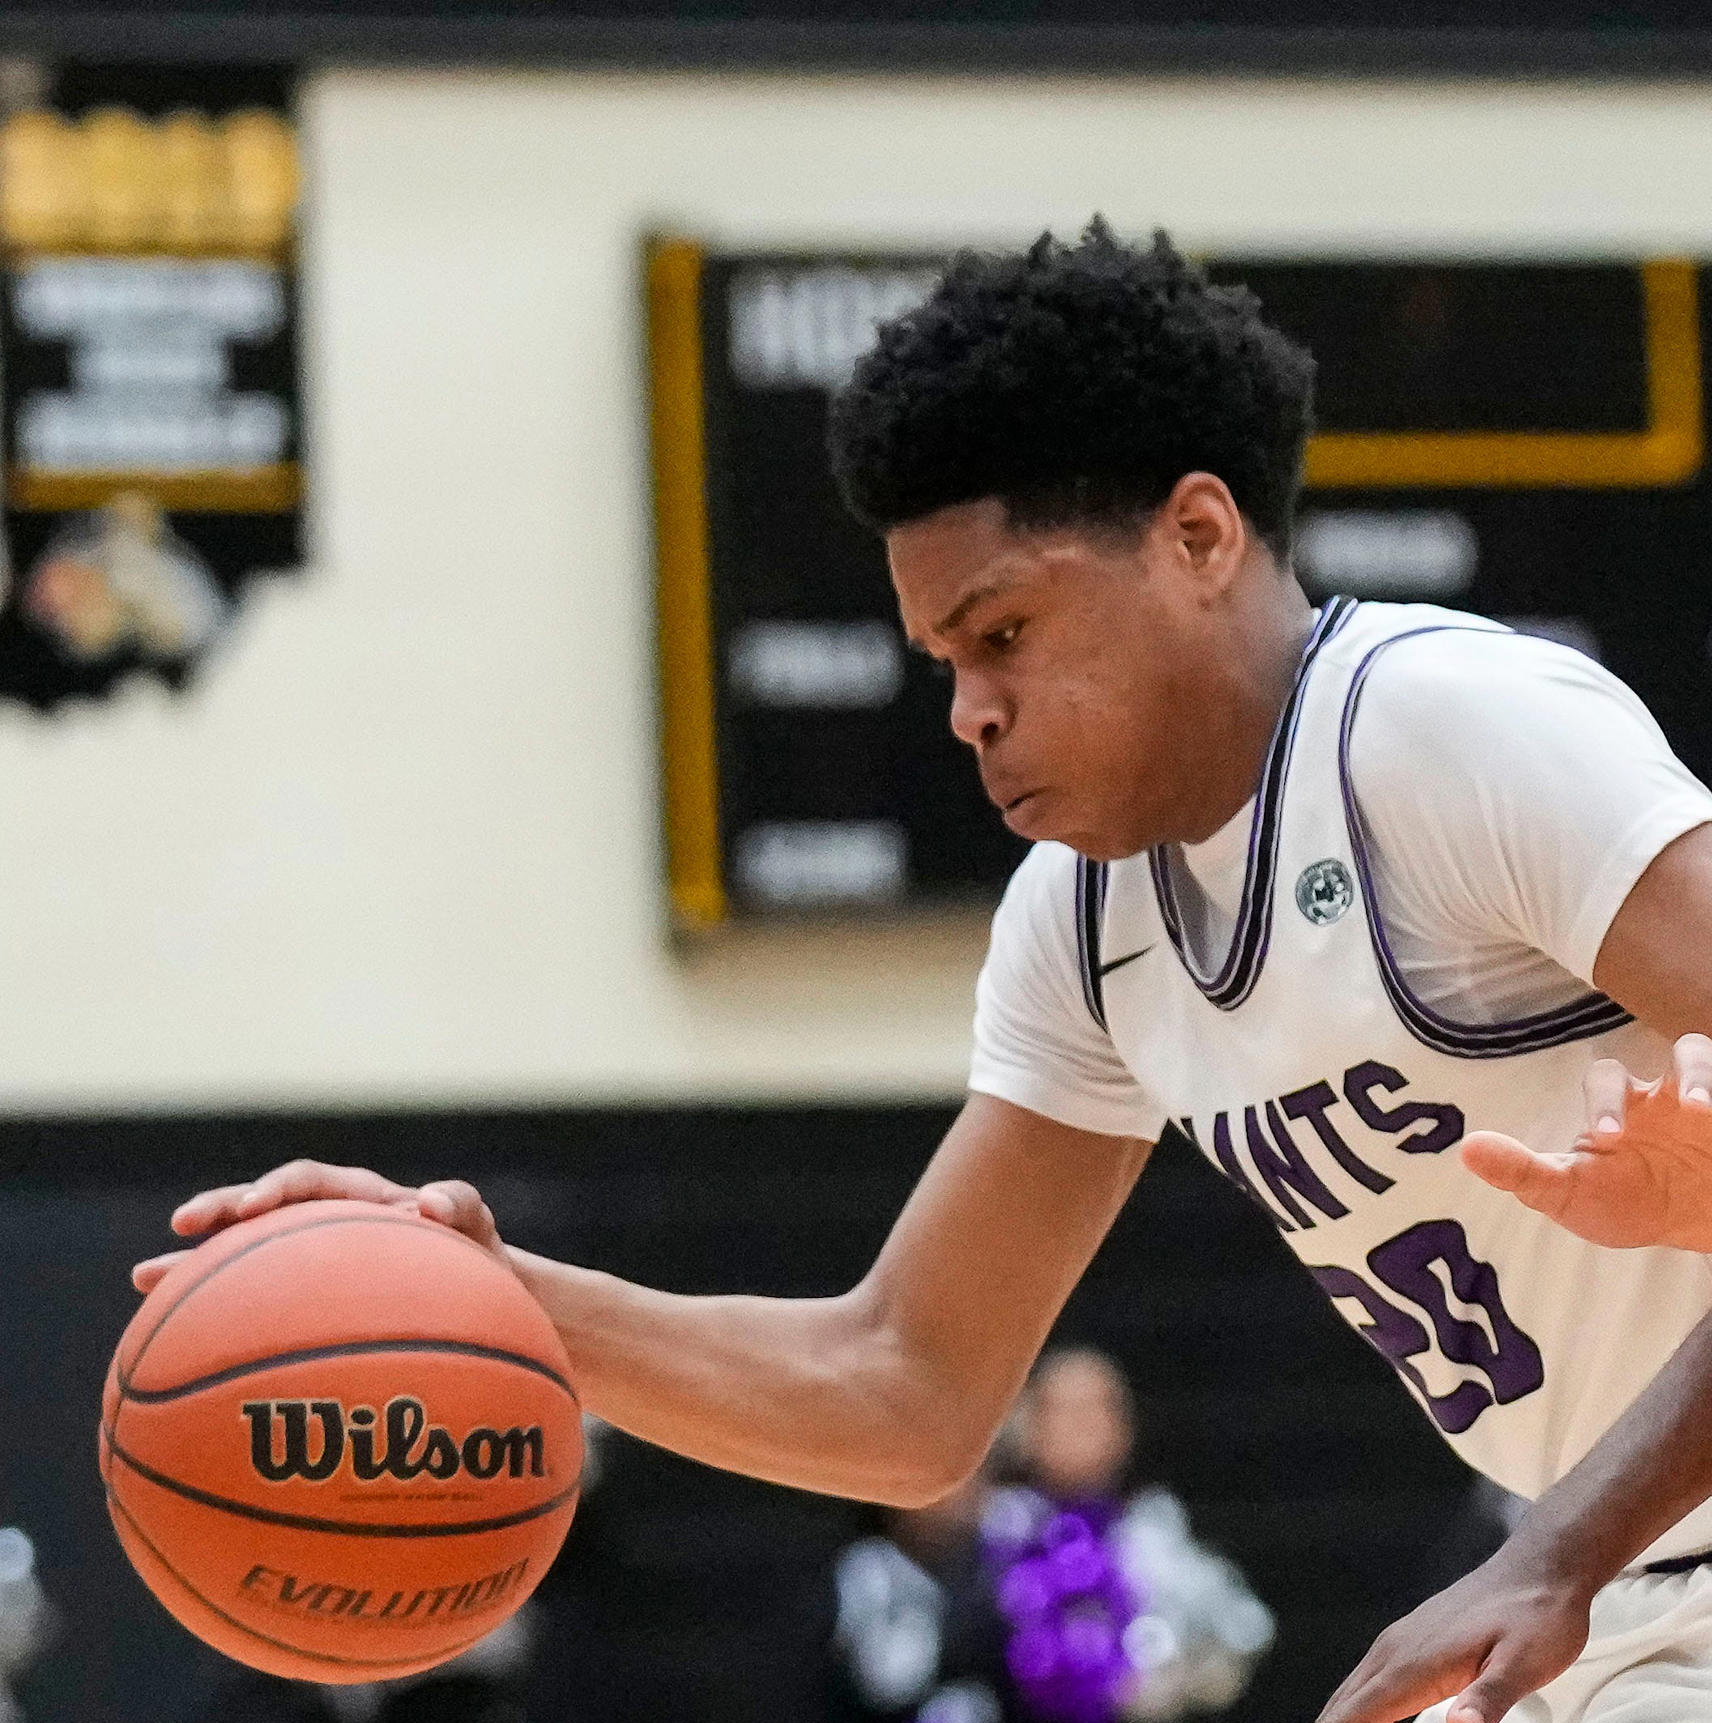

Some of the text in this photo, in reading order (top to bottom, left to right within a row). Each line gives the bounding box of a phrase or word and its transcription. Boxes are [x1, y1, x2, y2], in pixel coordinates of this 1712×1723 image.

[1303, 1218, 1545, 1435] 20
[239, 1394, 548, 1484] Wilson
[238, 1556, 530, 1619] EVOLUTION
